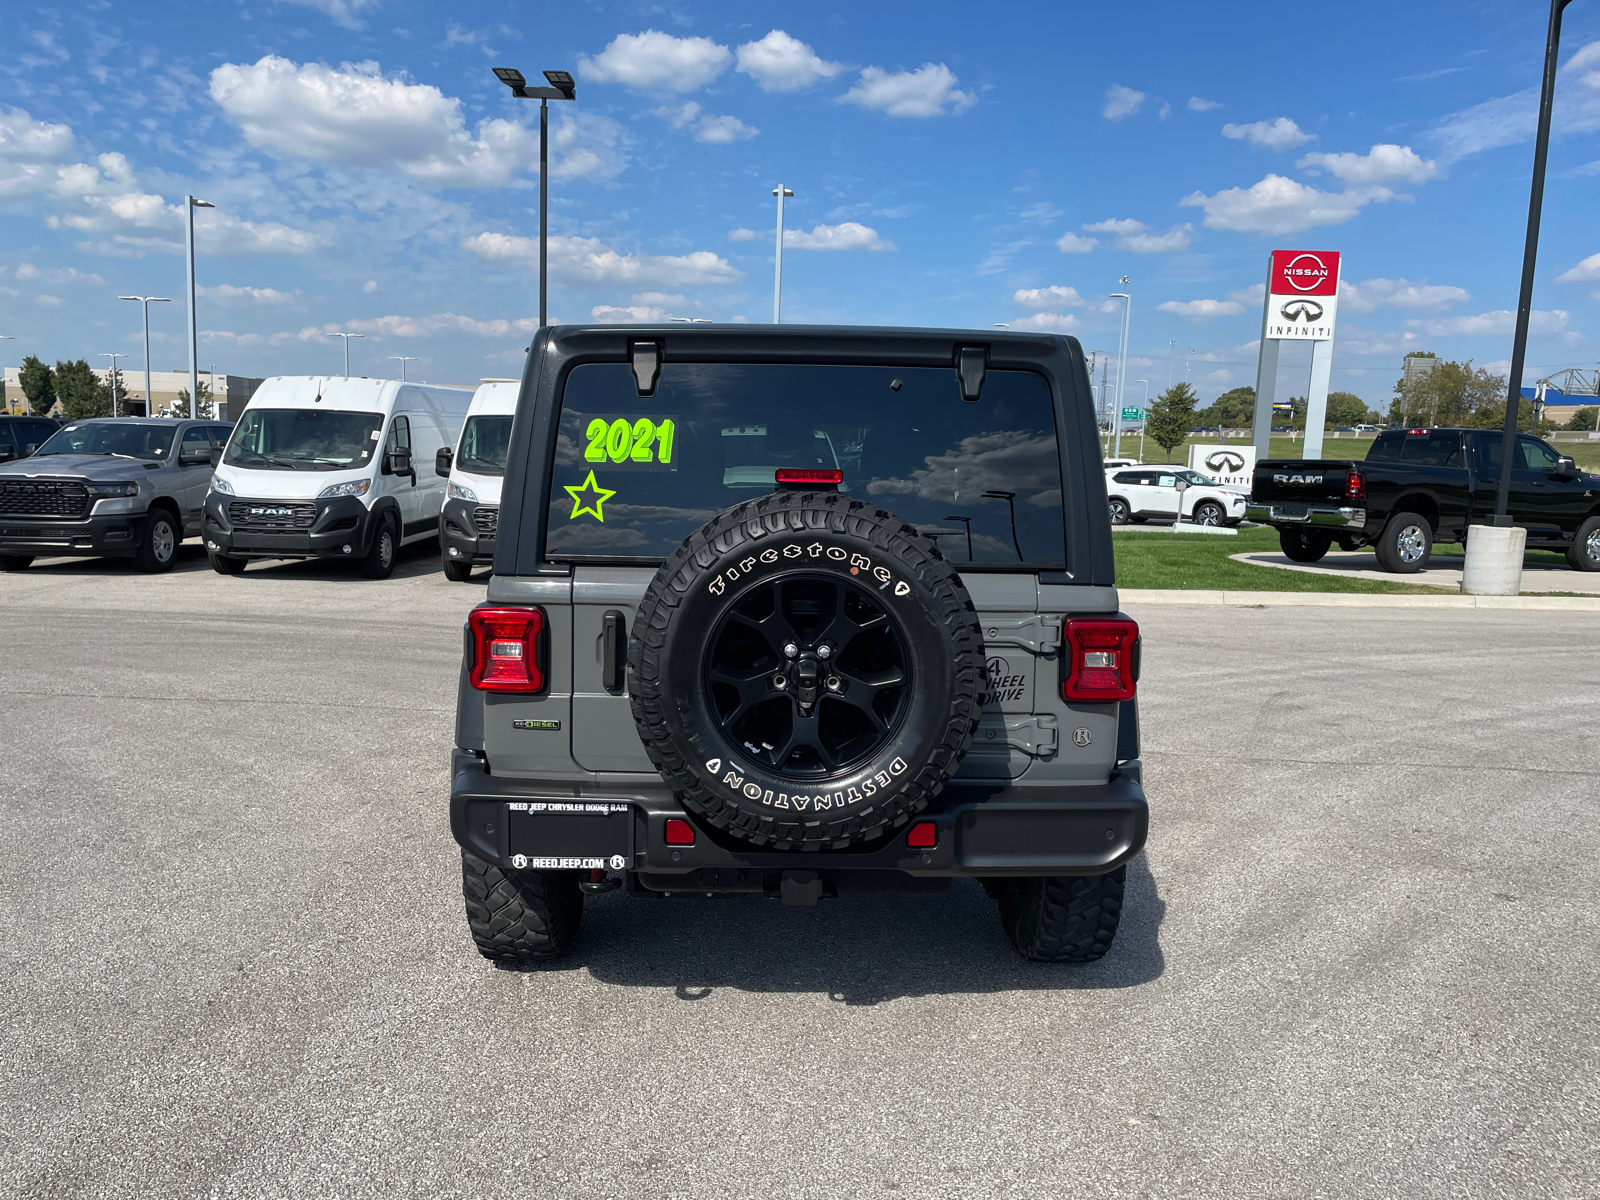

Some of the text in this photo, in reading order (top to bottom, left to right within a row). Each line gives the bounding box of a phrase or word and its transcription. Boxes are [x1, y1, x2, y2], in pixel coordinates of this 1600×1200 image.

[1284, 268, 1328, 276] NISSAN
[1270, 326, 1330, 336] INFINITI
[584, 418, 675, 464] 2021
[1273, 474, 1323, 484] RAM
[709, 542, 891, 595] Firestone
[987, 659, 1001, 676] 4
[723, 756, 907, 811] DESTINATION
[509, 803, 628, 812] REED JEEP CHRYSLER DODGE RAM
[533, 858, 604, 869] REEDJEEP.COM
